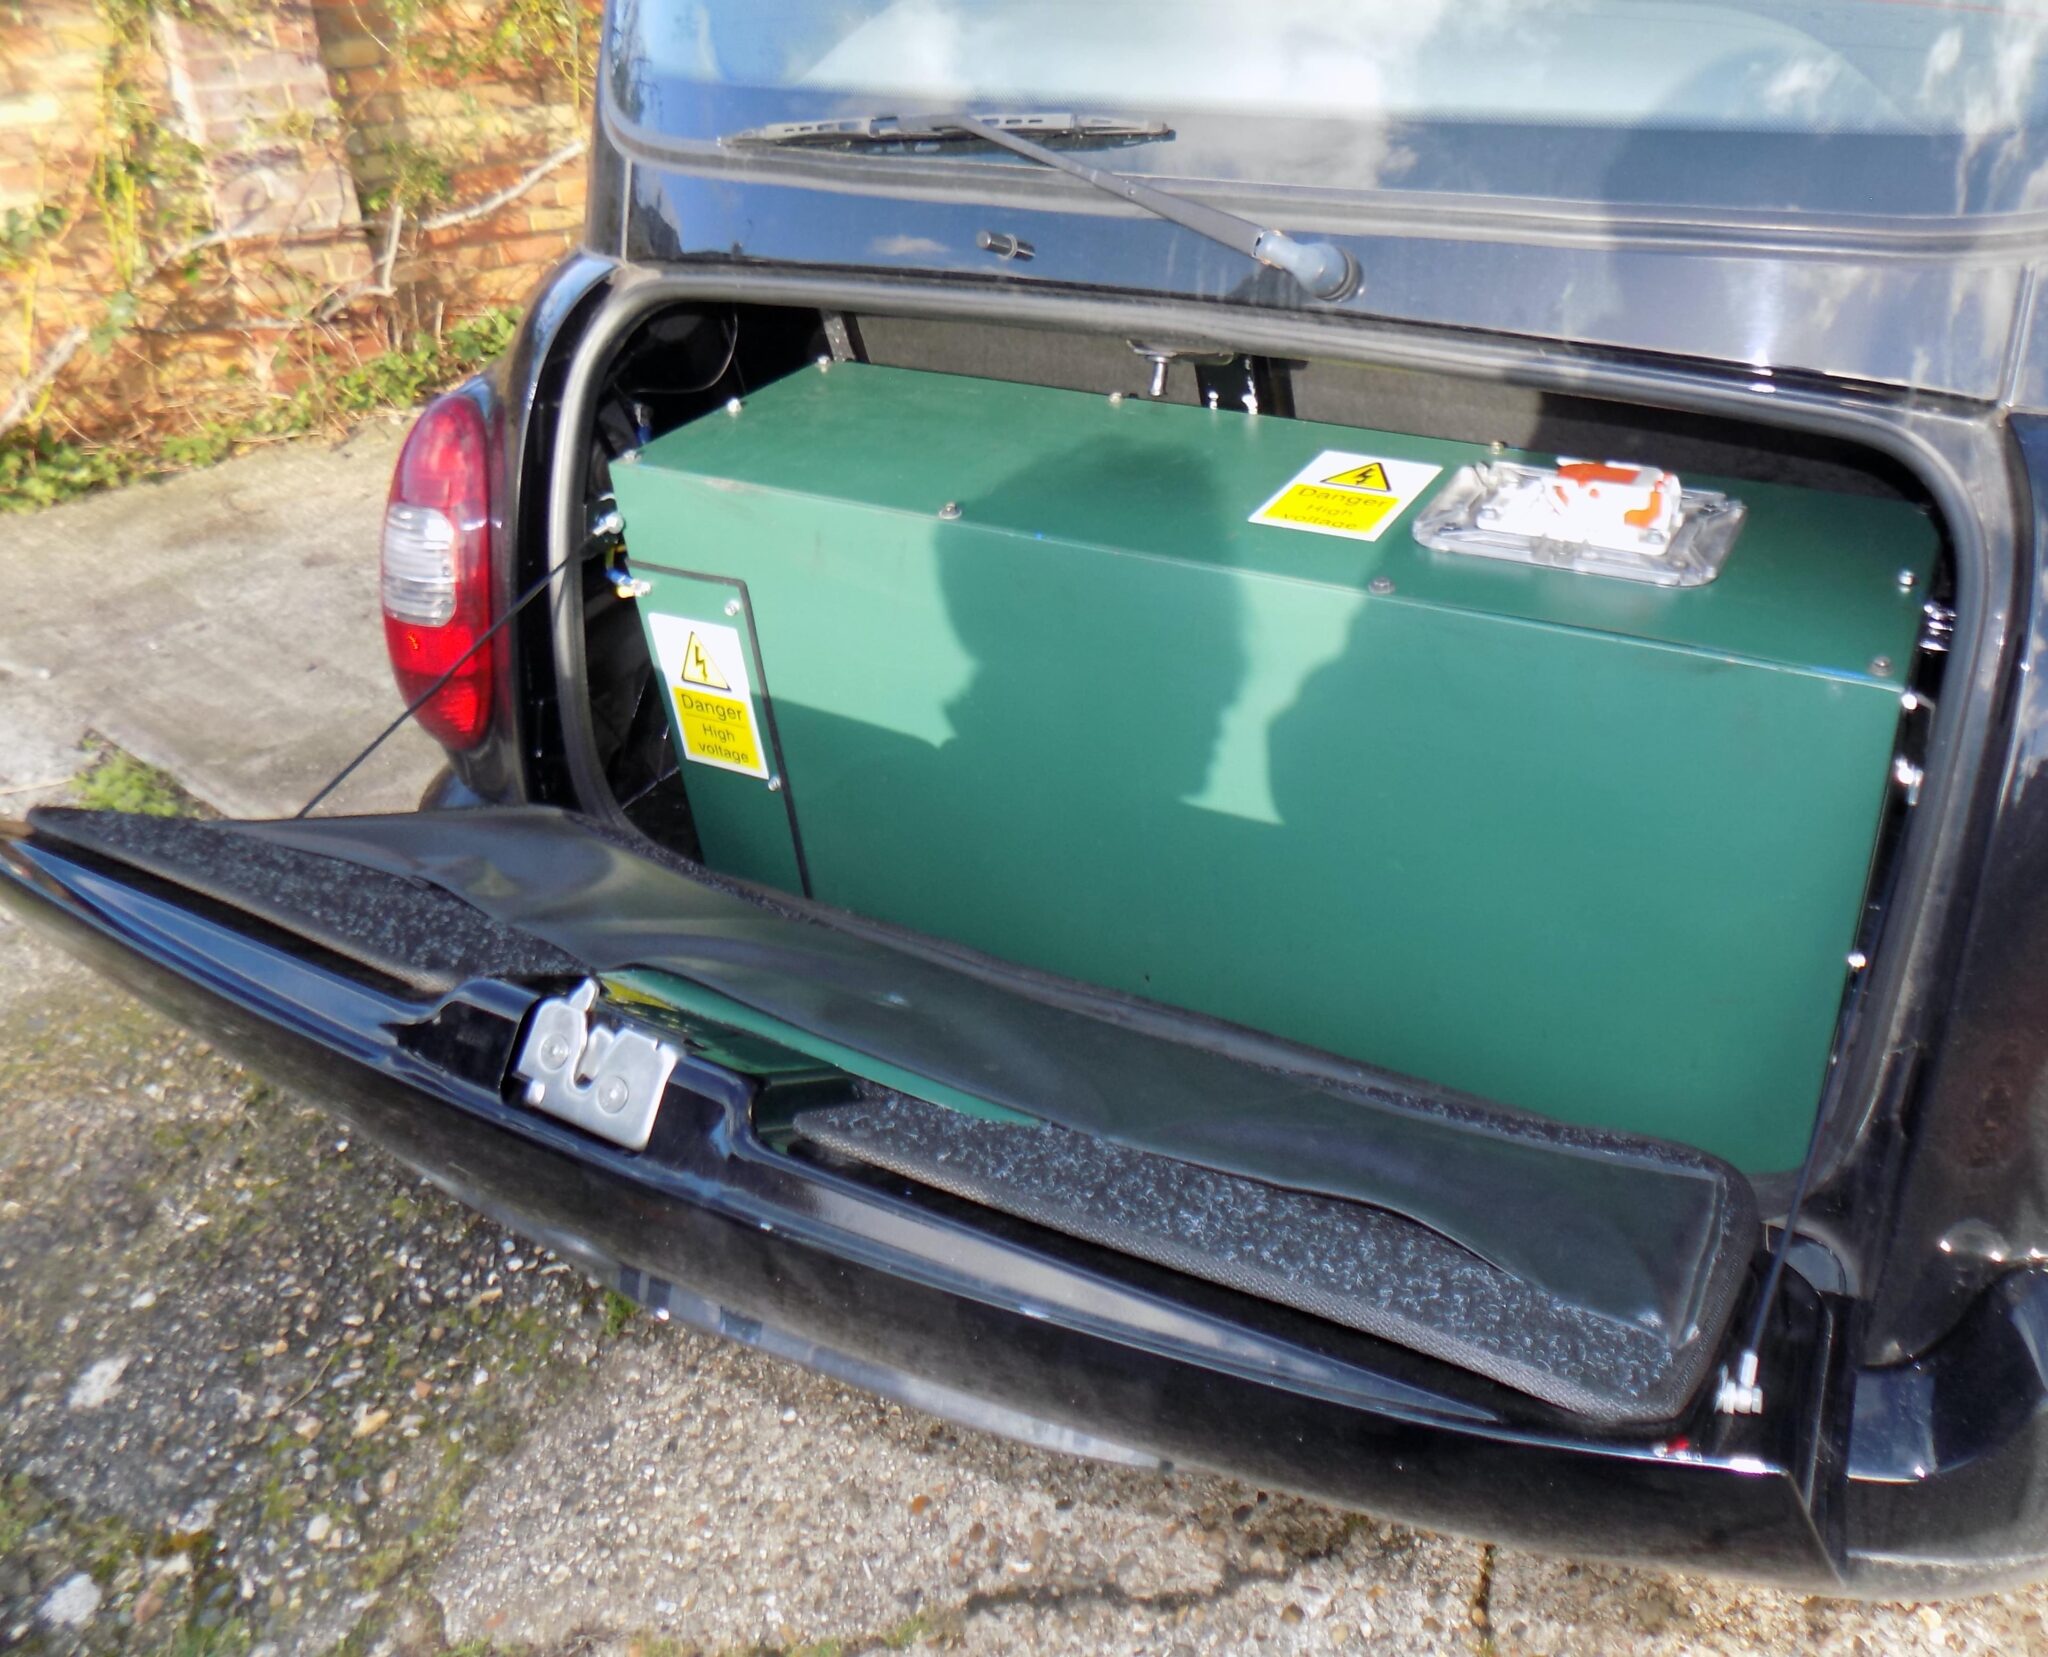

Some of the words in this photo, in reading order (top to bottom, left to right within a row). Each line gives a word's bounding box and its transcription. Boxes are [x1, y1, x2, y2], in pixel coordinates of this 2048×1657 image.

[1298, 488, 1388, 507] Danger
[1306, 503, 1353, 517] High
[1283, 512, 1357, 531] voltage
[681, 693, 742, 721] Danger
[702, 723, 735, 742] High
[698, 742, 749, 763] voltage
